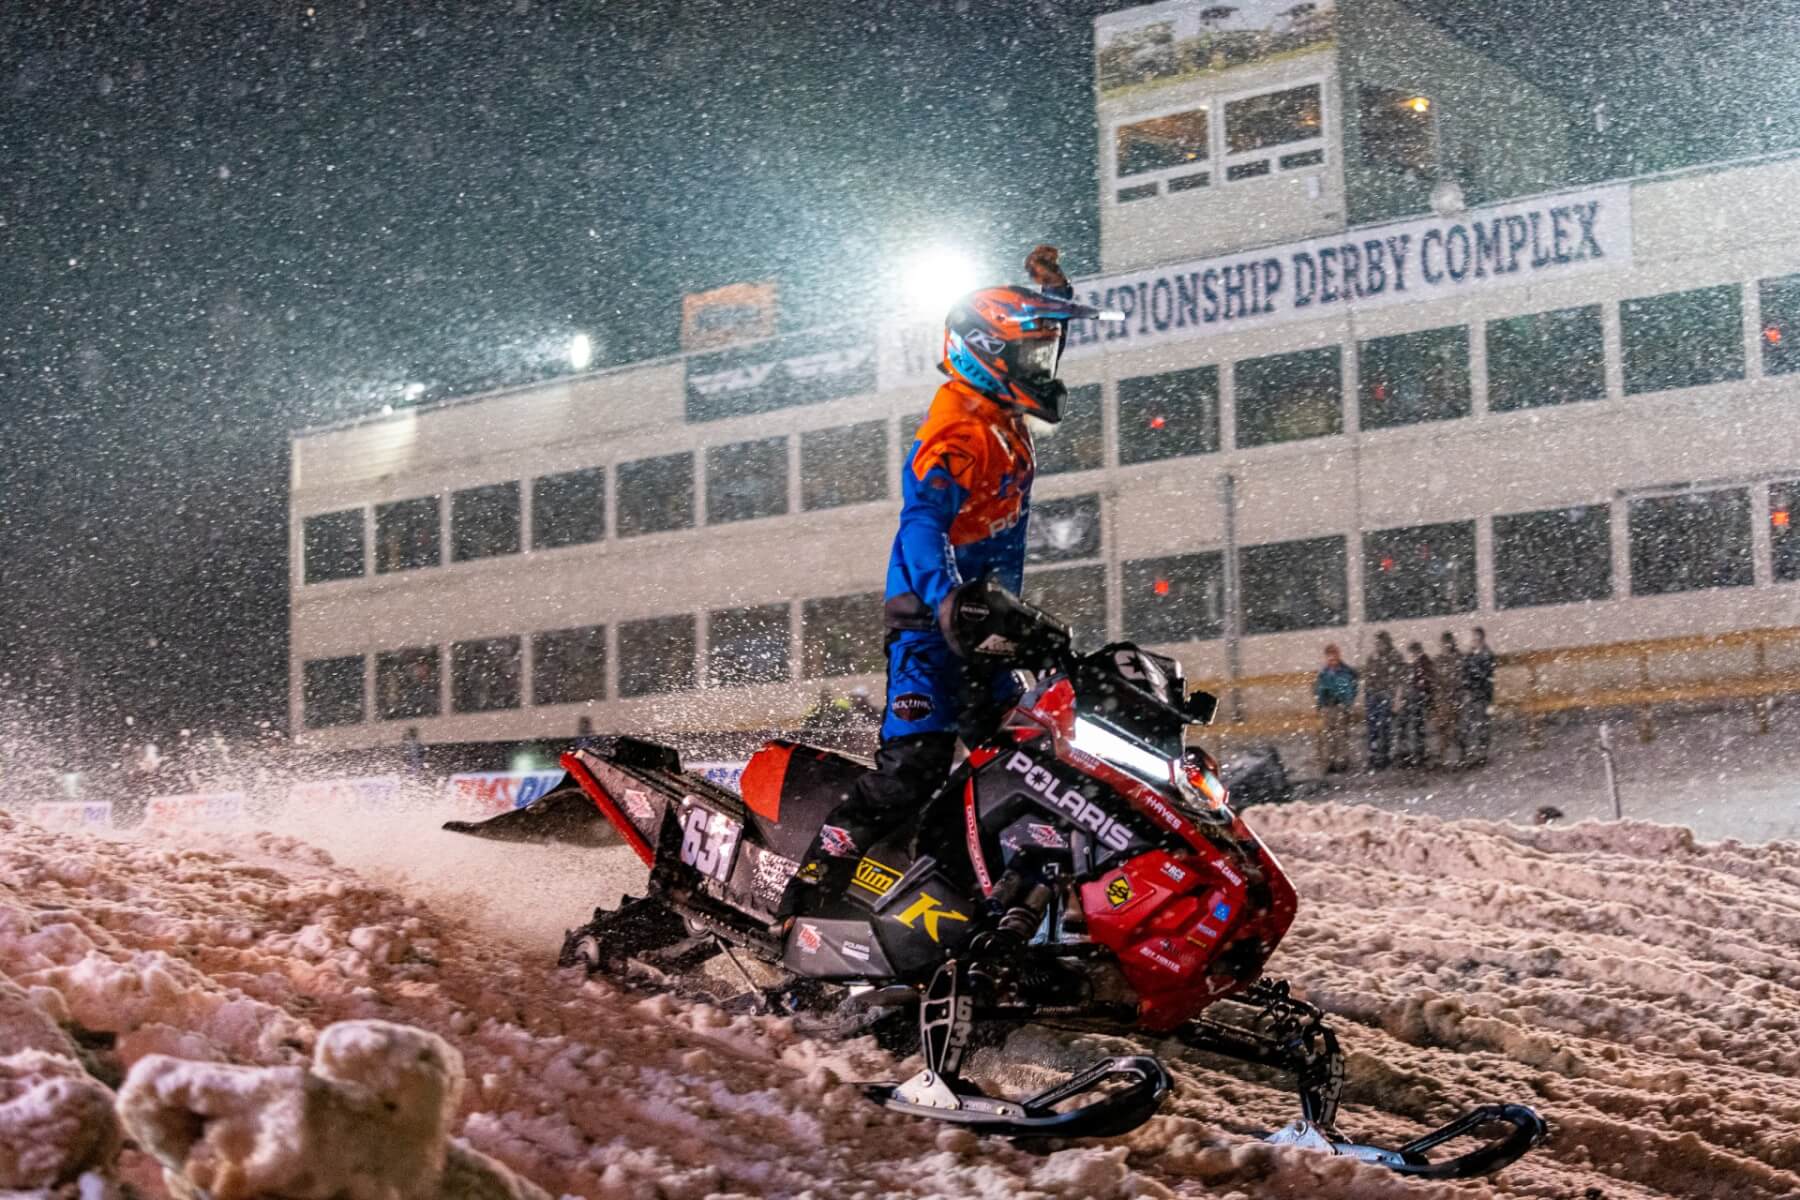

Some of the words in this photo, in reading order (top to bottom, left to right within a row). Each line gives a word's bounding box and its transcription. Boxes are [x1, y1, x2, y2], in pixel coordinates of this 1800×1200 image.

[1066, 256, 1283, 348] AMPIONSHIP
[1292, 232, 1411, 306] DERBY
[1421, 202, 1604, 282] COMPLEX
[1005, 751, 1133, 851] POLARIS
[892, 892, 969, 943] K
